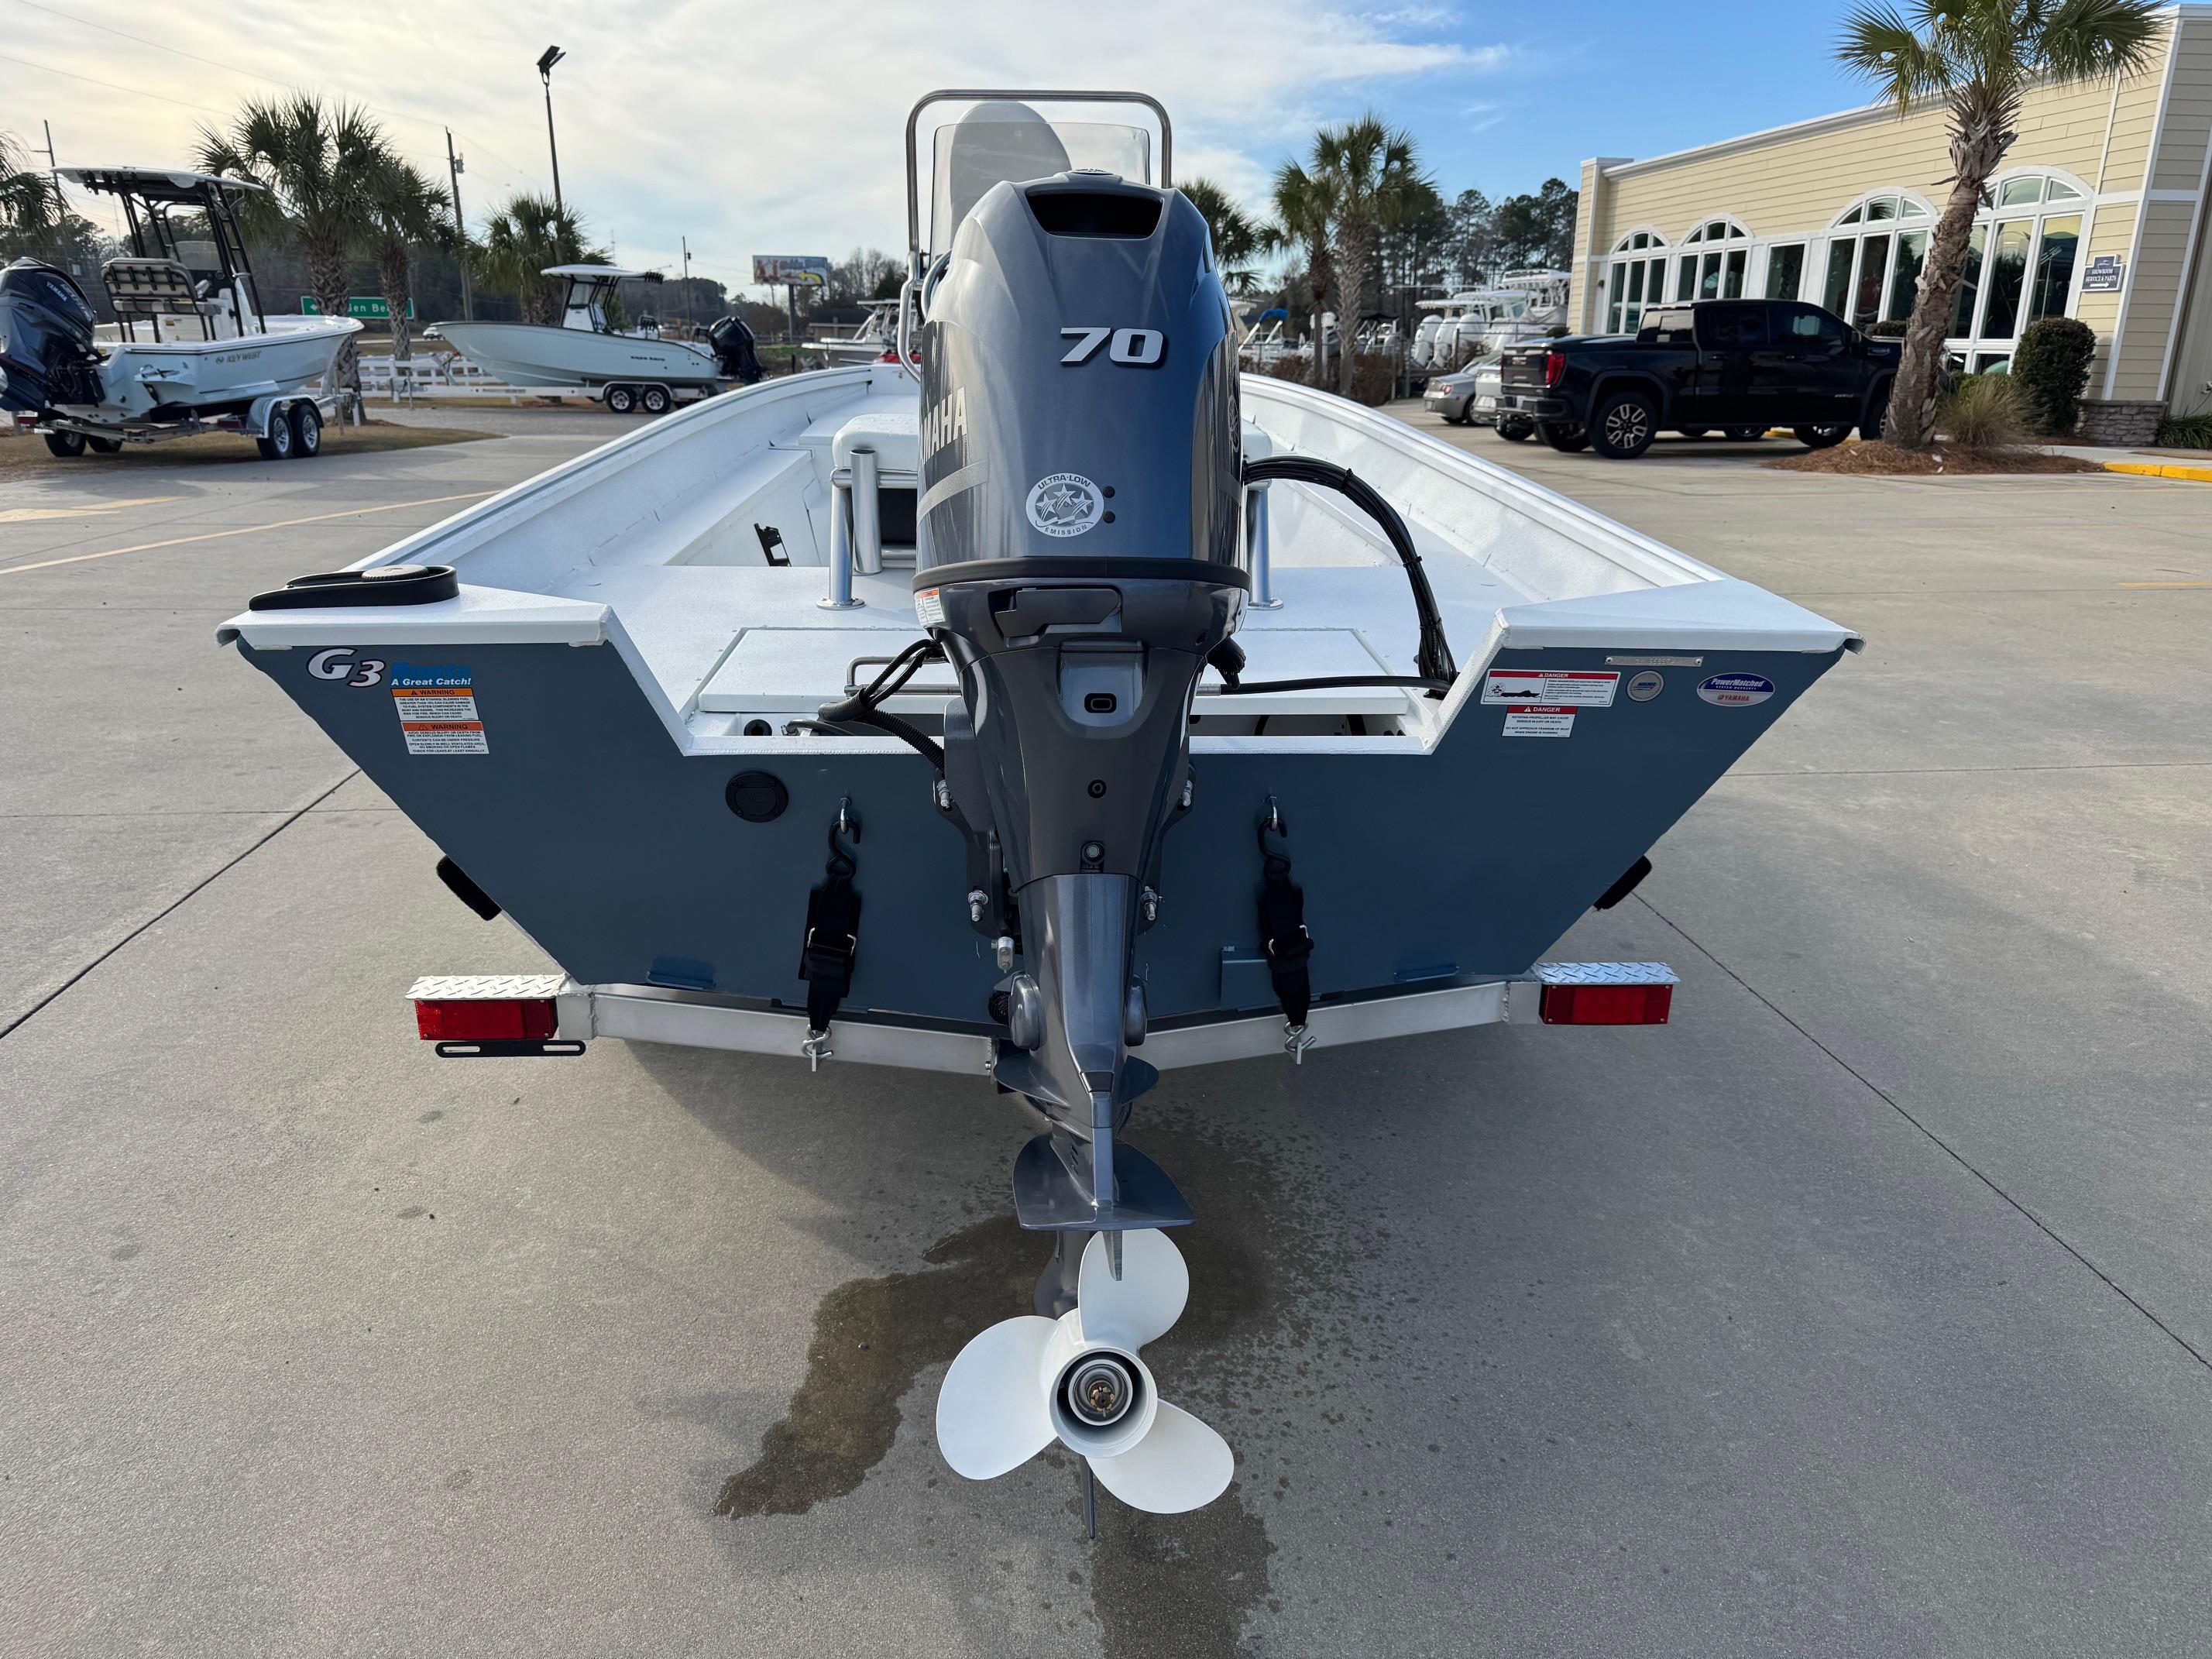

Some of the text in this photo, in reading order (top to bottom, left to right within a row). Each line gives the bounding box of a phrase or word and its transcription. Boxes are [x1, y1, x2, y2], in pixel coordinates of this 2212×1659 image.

[46, 280, 67, 302] YAMAHA
[1060, 327, 1163, 363] 70
[1045, 525, 1087, 535] EMISSION
[306, 647, 386, 687] G3
[392, 661, 470, 676] Boats
[1711, 678, 1766, 687] PowerMatched
